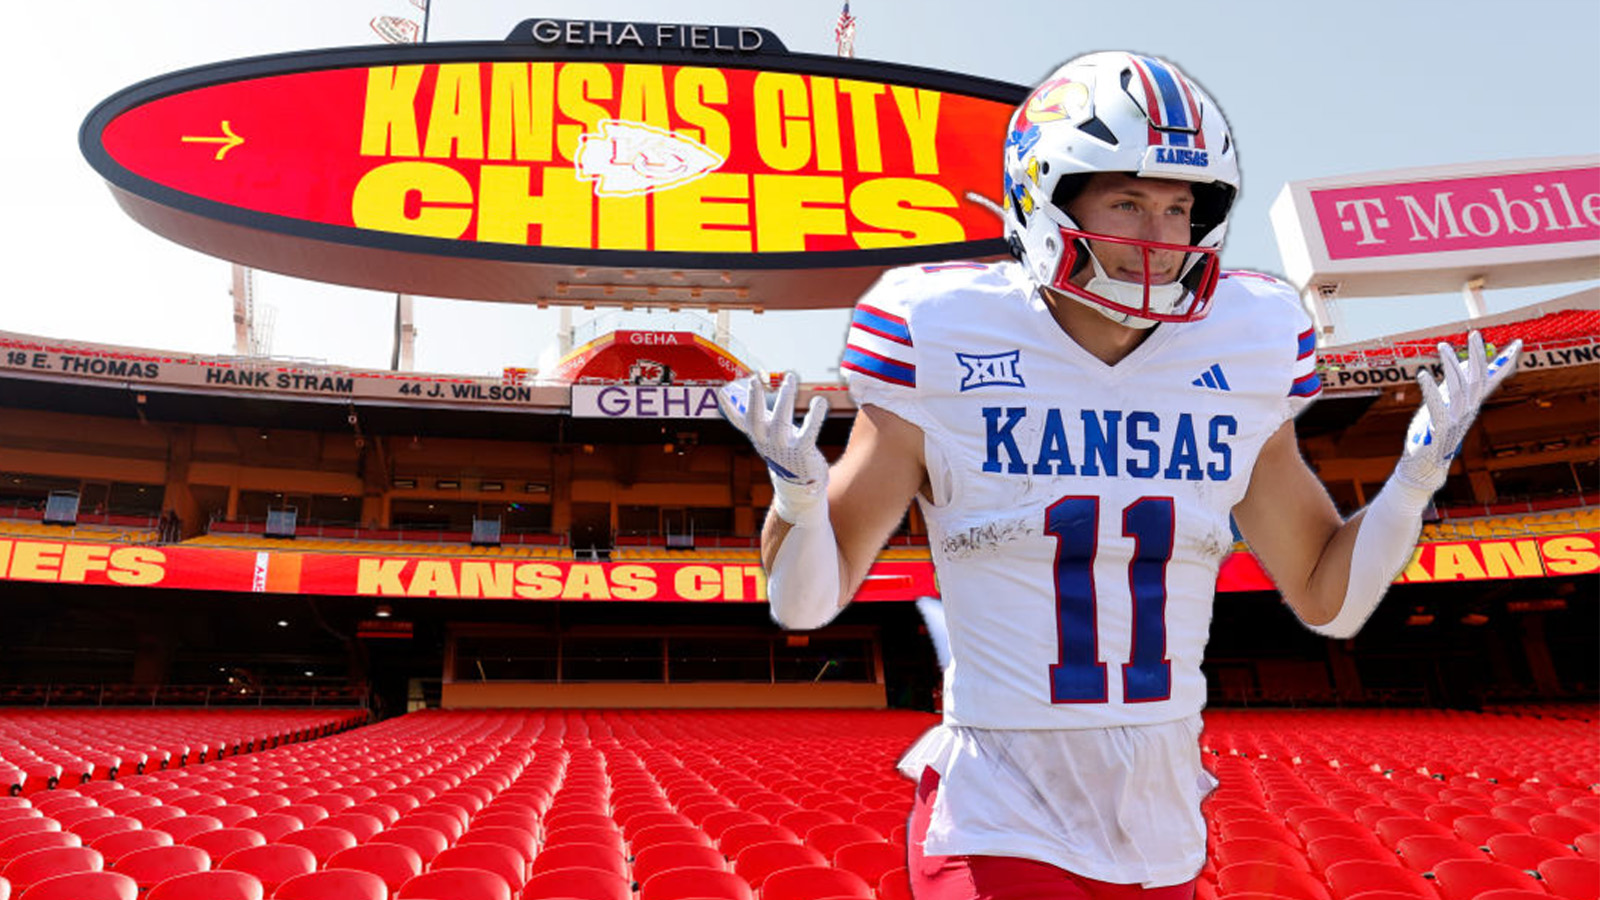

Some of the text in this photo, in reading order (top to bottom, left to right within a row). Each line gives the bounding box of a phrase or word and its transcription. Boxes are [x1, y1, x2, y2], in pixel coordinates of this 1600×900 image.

[532, 20, 763, 50] GEHA FIELD
[360, 62, 941, 175] KANSAS CITY
[1155, 147, 1209, 168] KANSAS
[351, 161, 966, 253] CHIEFS
[630, 333, 678, 345] GEHA
[7, 351, 159, 379] 18 E. THOMAS
[1524, 353, 1544, 368] J.
[206, 368, 354, 393] HANK STRAM
[399, 383, 531, 402] 44 J. WILSON
[597, 386, 719, 416] GEHA
[982, 407, 1237, 481] KANSAS
[357, 559, 657, 600] KANSAS
[1044, 495, 1174, 704] 11
